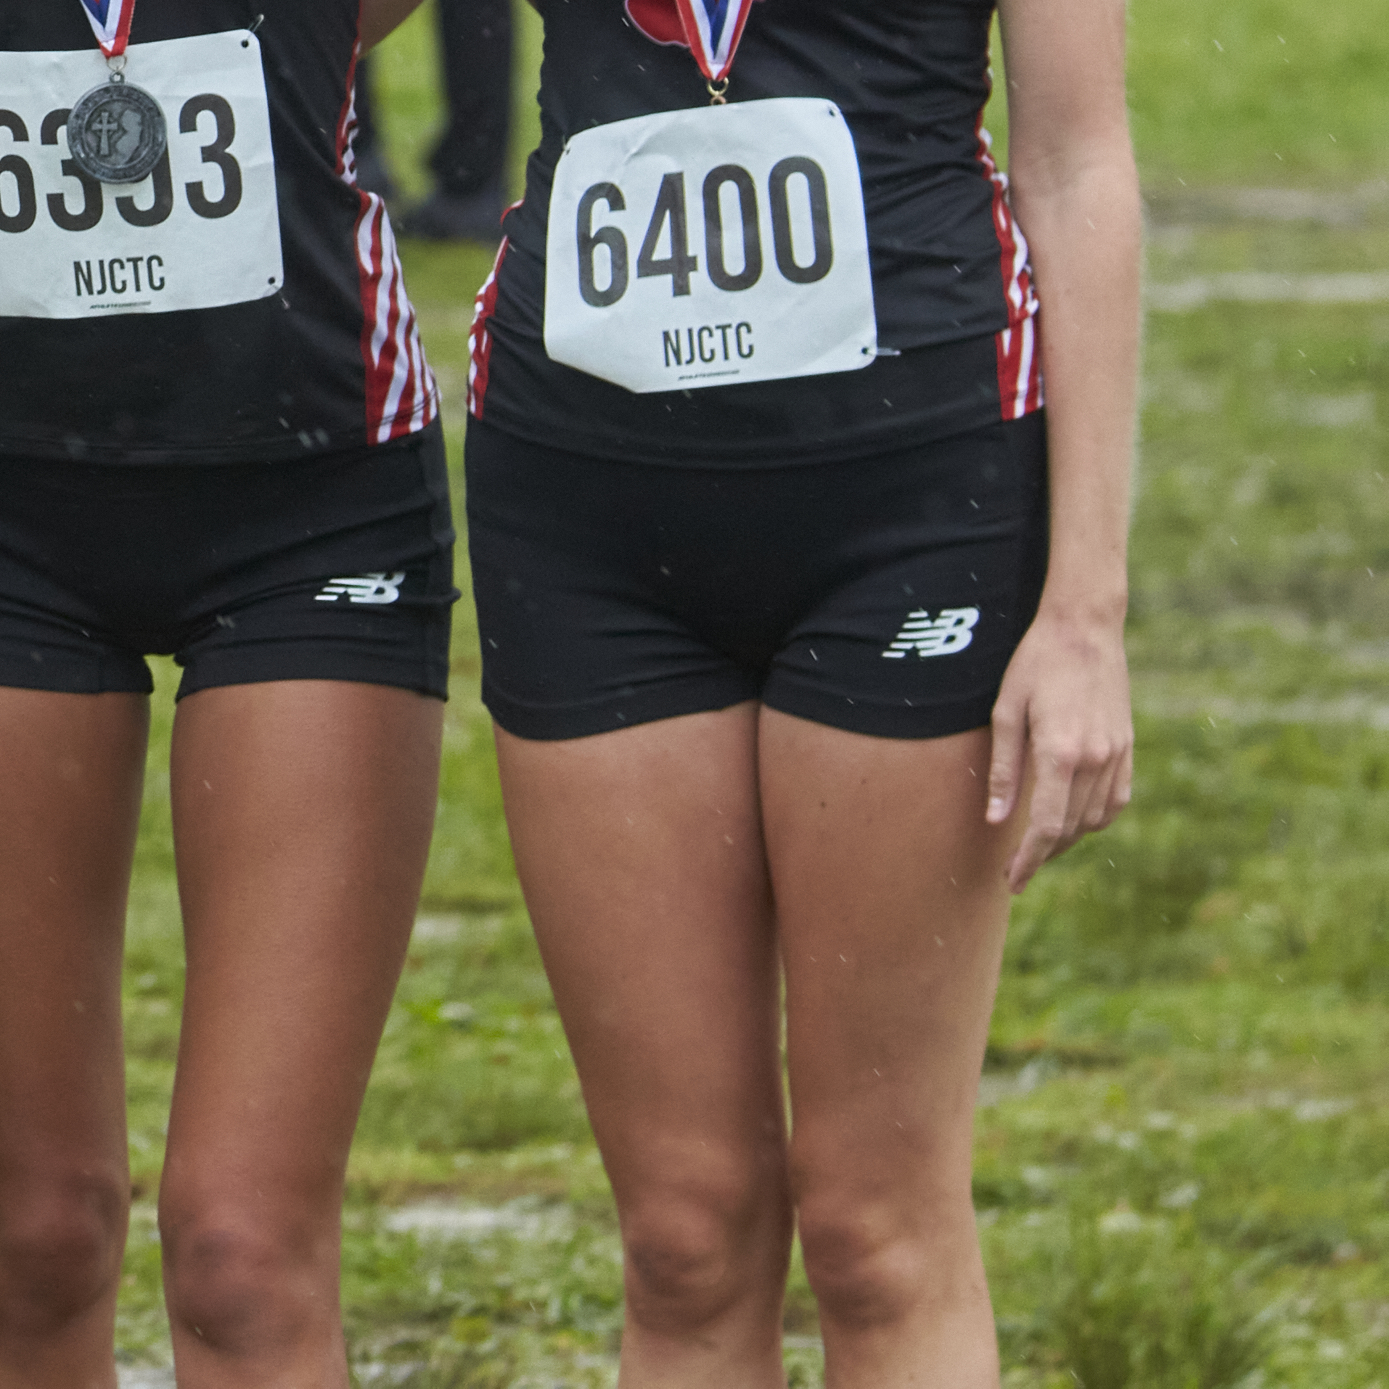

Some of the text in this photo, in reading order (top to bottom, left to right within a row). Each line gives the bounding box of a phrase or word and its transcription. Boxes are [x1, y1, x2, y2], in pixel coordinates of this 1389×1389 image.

[576, 156, 834, 308] 6400
[73, 255, 166, 297] NJCTC
[663, 322, 755, 368] NJCTC
